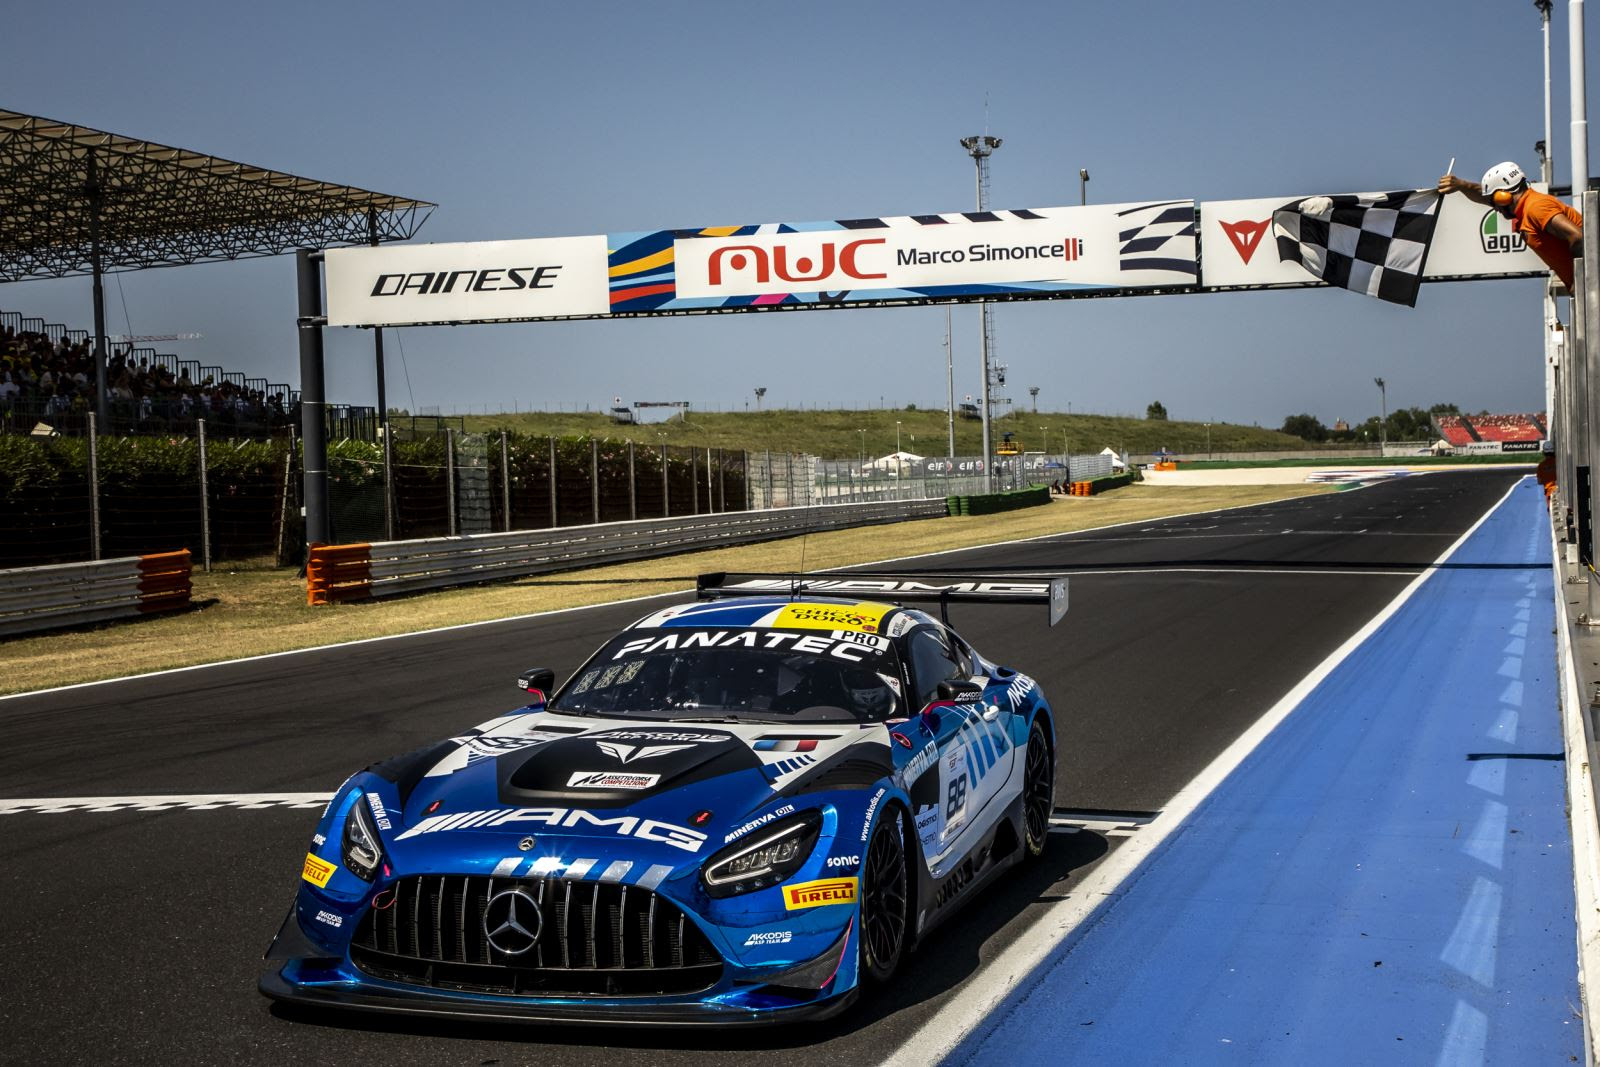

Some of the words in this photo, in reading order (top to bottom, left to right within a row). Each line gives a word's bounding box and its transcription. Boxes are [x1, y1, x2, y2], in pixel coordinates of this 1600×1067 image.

[897, 248, 965, 266] Marco
[969, 238, 1083, 263] Simoncelli
[1487, 235, 1523, 253] agv
[370, 265, 563, 297] DAINESE
[927, 461, 945, 471] elf
[959, 461, 974, 470] elf
[612, 631, 874, 662] FANATEC
[841, 630, 879, 647] PRO
[946, 773, 967, 820] 88
[724, 813, 776, 843] MINERVA
[775, 804, 795, 817] OIL
[861, 788, 886, 841] www.akkodis.com
[790, 882, 853, 904] PIRELLI
